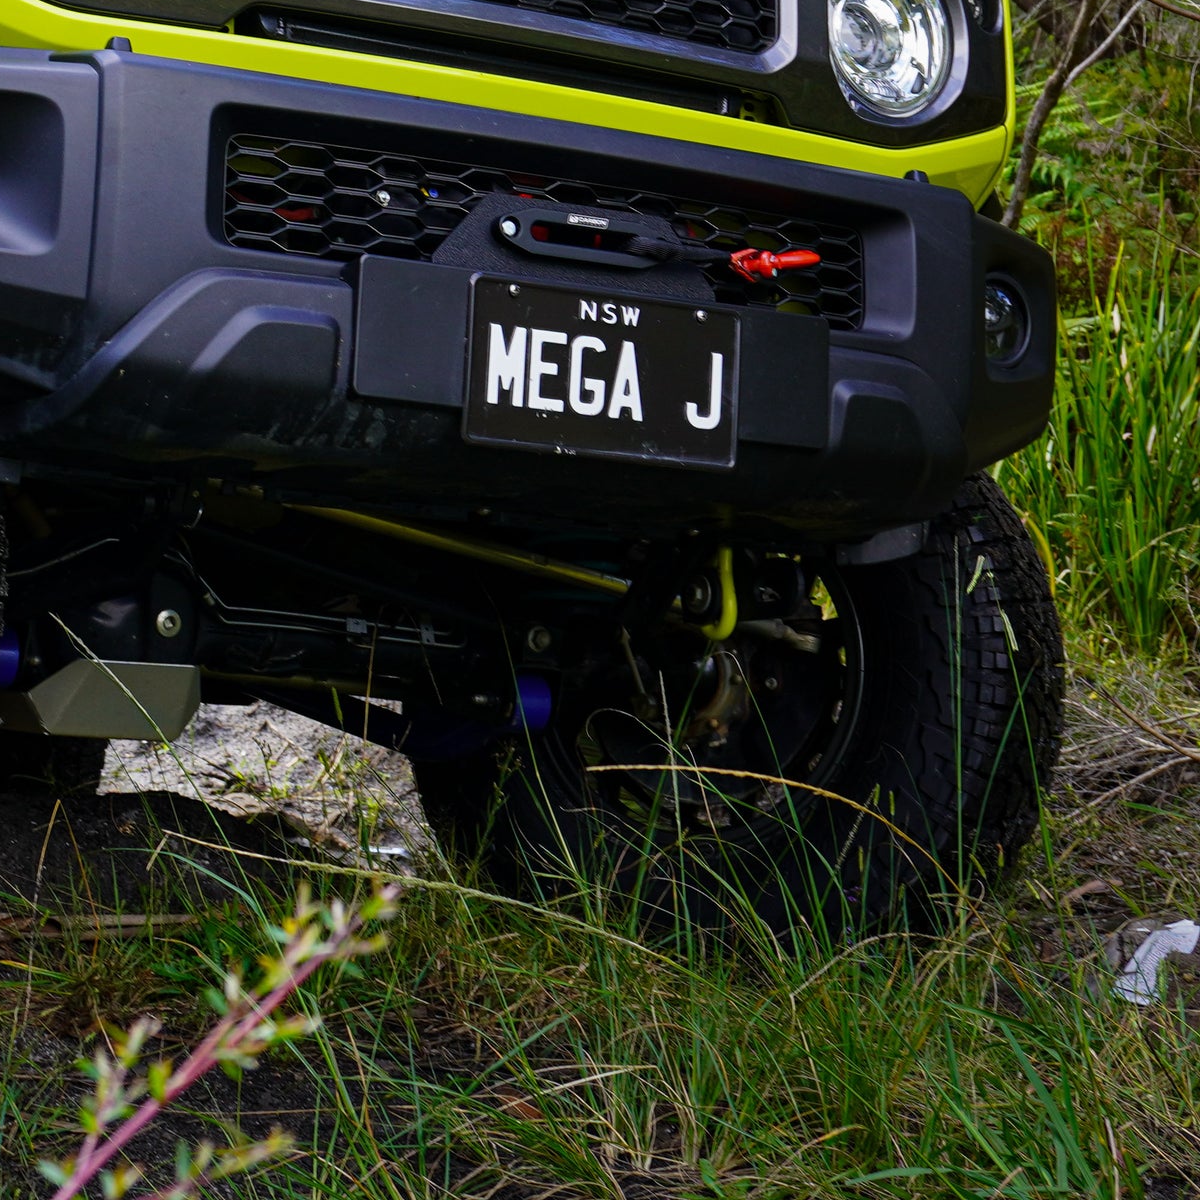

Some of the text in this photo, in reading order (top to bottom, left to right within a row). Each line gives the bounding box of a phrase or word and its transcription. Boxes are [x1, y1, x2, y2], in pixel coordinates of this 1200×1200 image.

[579, 298, 642, 328] NSW
[485, 322, 724, 431] MEGA J
